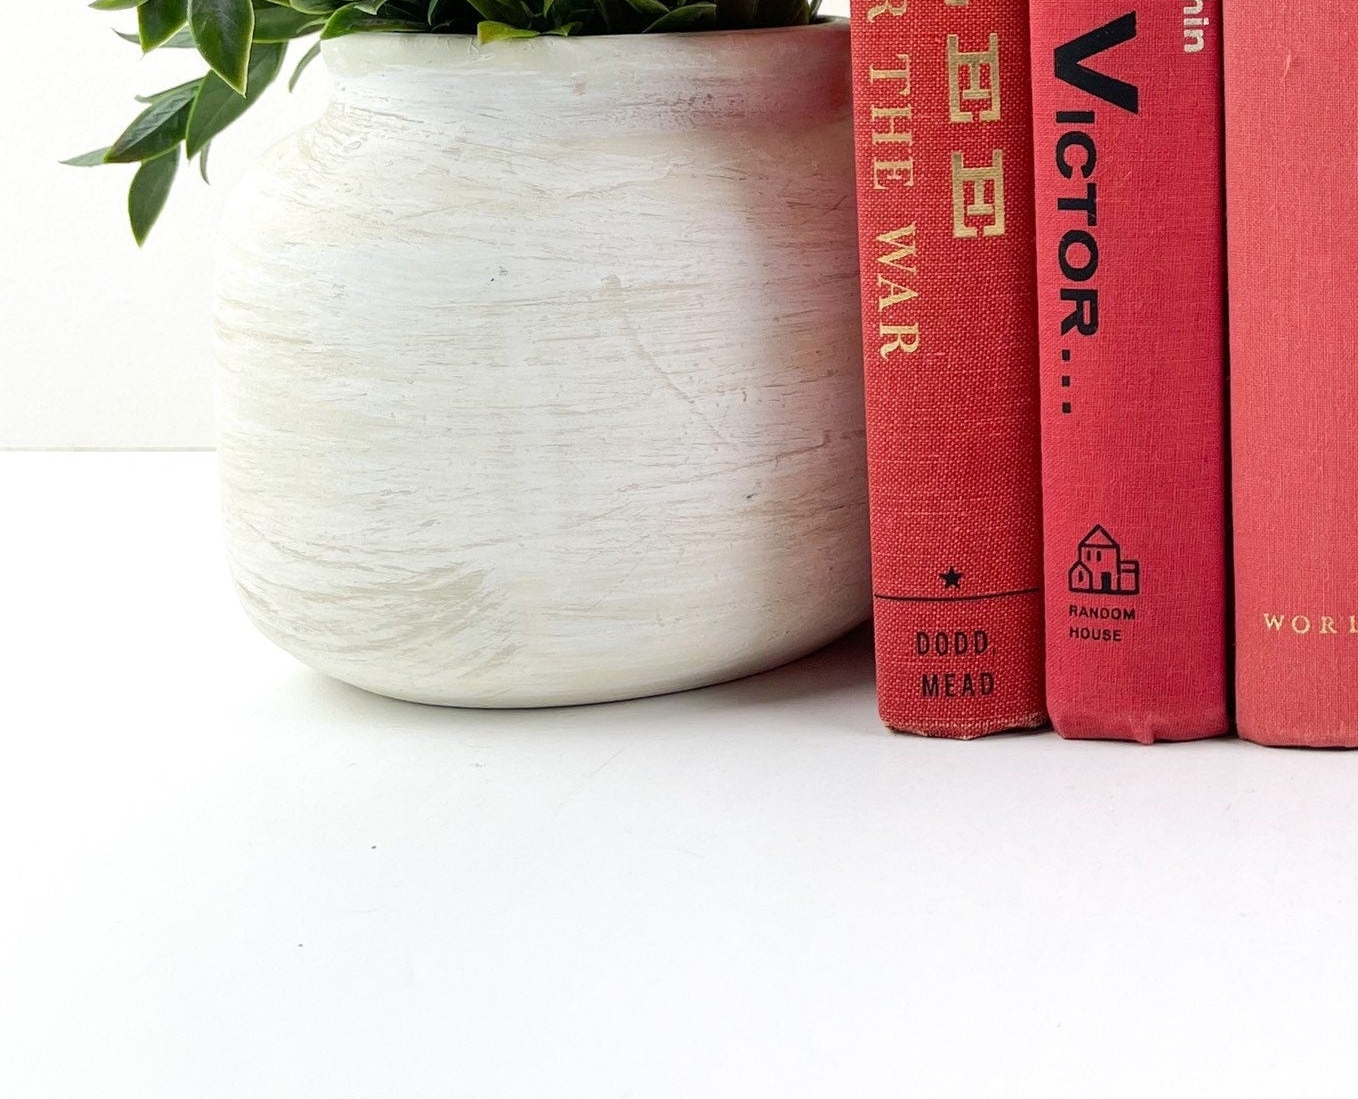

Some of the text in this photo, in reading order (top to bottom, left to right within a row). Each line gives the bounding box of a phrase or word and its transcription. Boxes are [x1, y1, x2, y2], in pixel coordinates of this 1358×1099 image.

[868, 54, 914, 189] THE
[873, 221, 920, 360] WAR
[1068, 603, 1136, 620] RANDOM
[1069, 626, 1122, 642] HOUSE
[921, 671, 995, 698] MEAD
